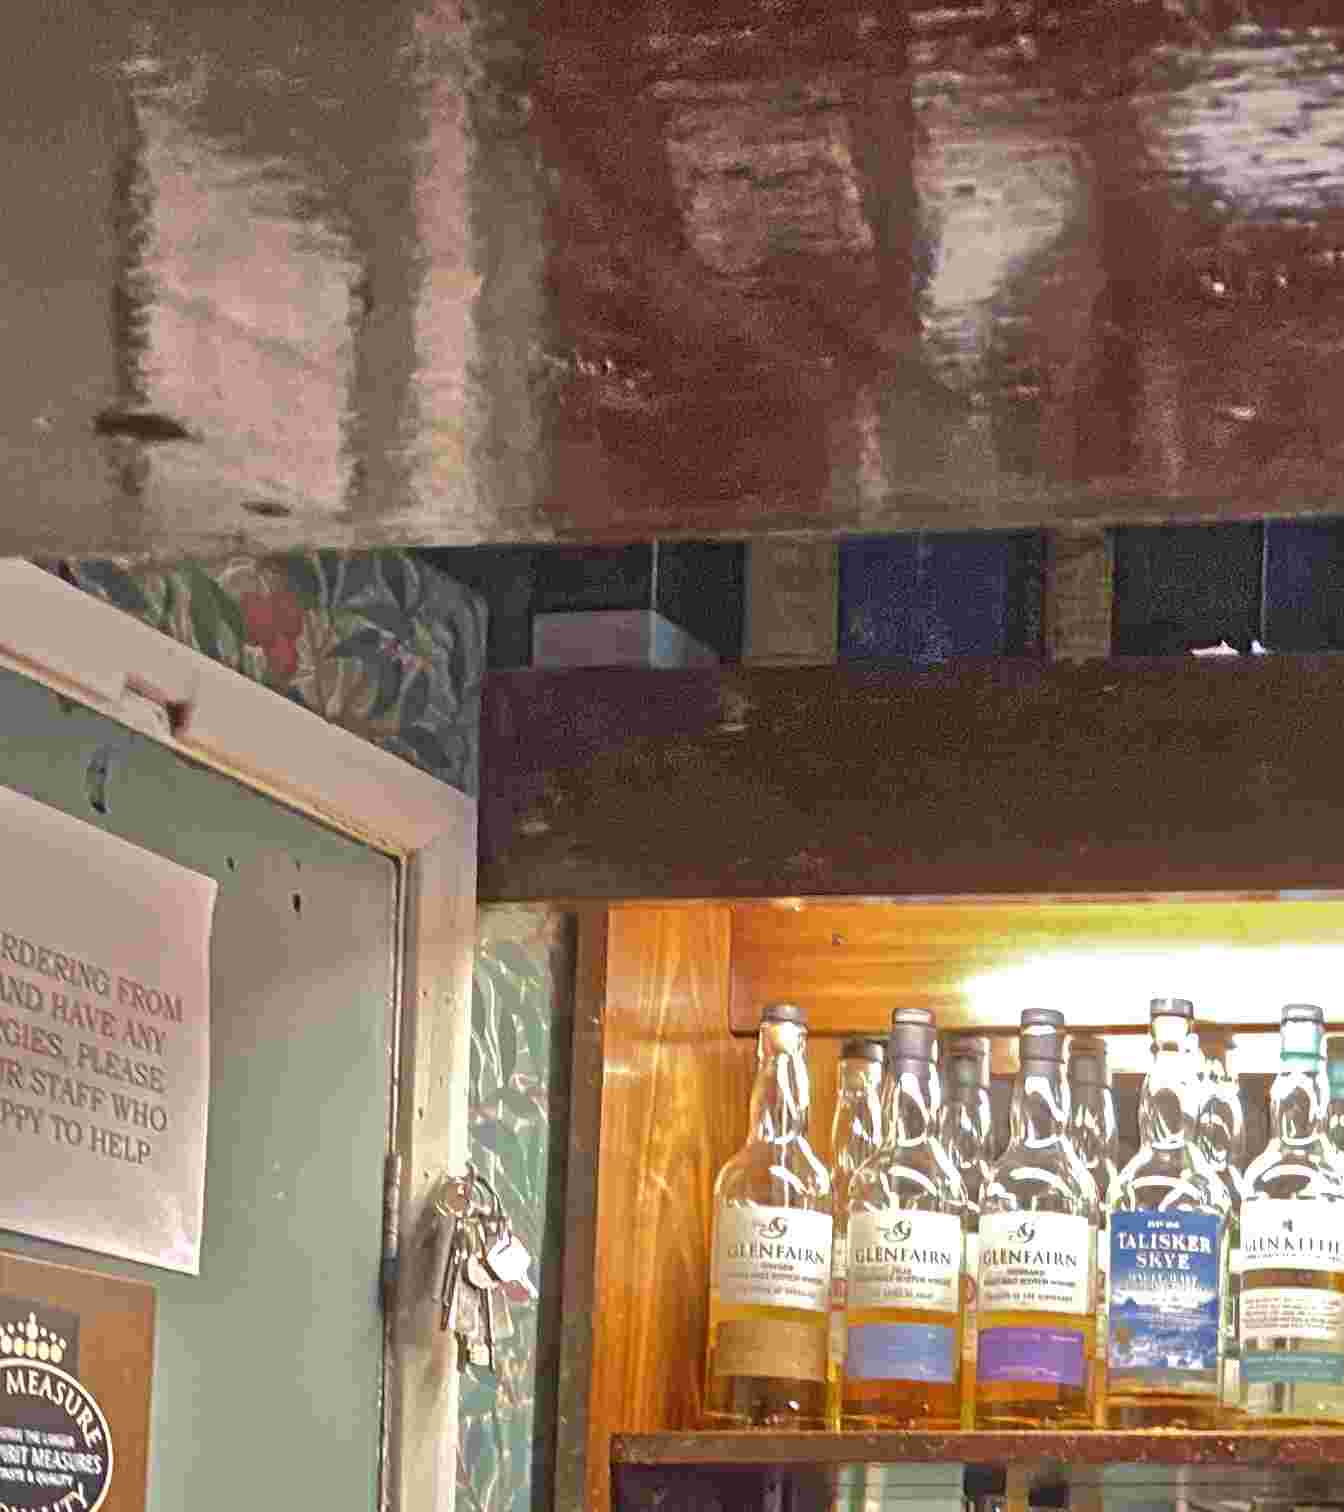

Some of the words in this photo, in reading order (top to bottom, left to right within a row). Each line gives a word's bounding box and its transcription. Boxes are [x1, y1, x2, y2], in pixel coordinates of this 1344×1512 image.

[116, 976, 184, 1024] FROM
[52, 990, 119, 1040] HAVE
[121, 1018, 168, 1057] ANY
[78, 1041, 166, 1095] PLEASE
[30, 1067, 106, 1113] STAFF
[111, 1091, 169, 1133] WHO
[49, 1112, 84, 1147] TO
[88, 1124, 152, 1167] HELP
[727, 1242, 826, 1265] GLENFAIRN
[855, 1248, 952, 1266] GLENFAIRN
[982, 1249, 1079, 1267] GLENFAIRN
[1118, 1231, 1212, 1254] TALISKER
[1135, 1253, 1192, 1271] SKYE
[6, 1369, 104, 1449] MEASURE
[31, 1445, 103, 1475] MEASURES
